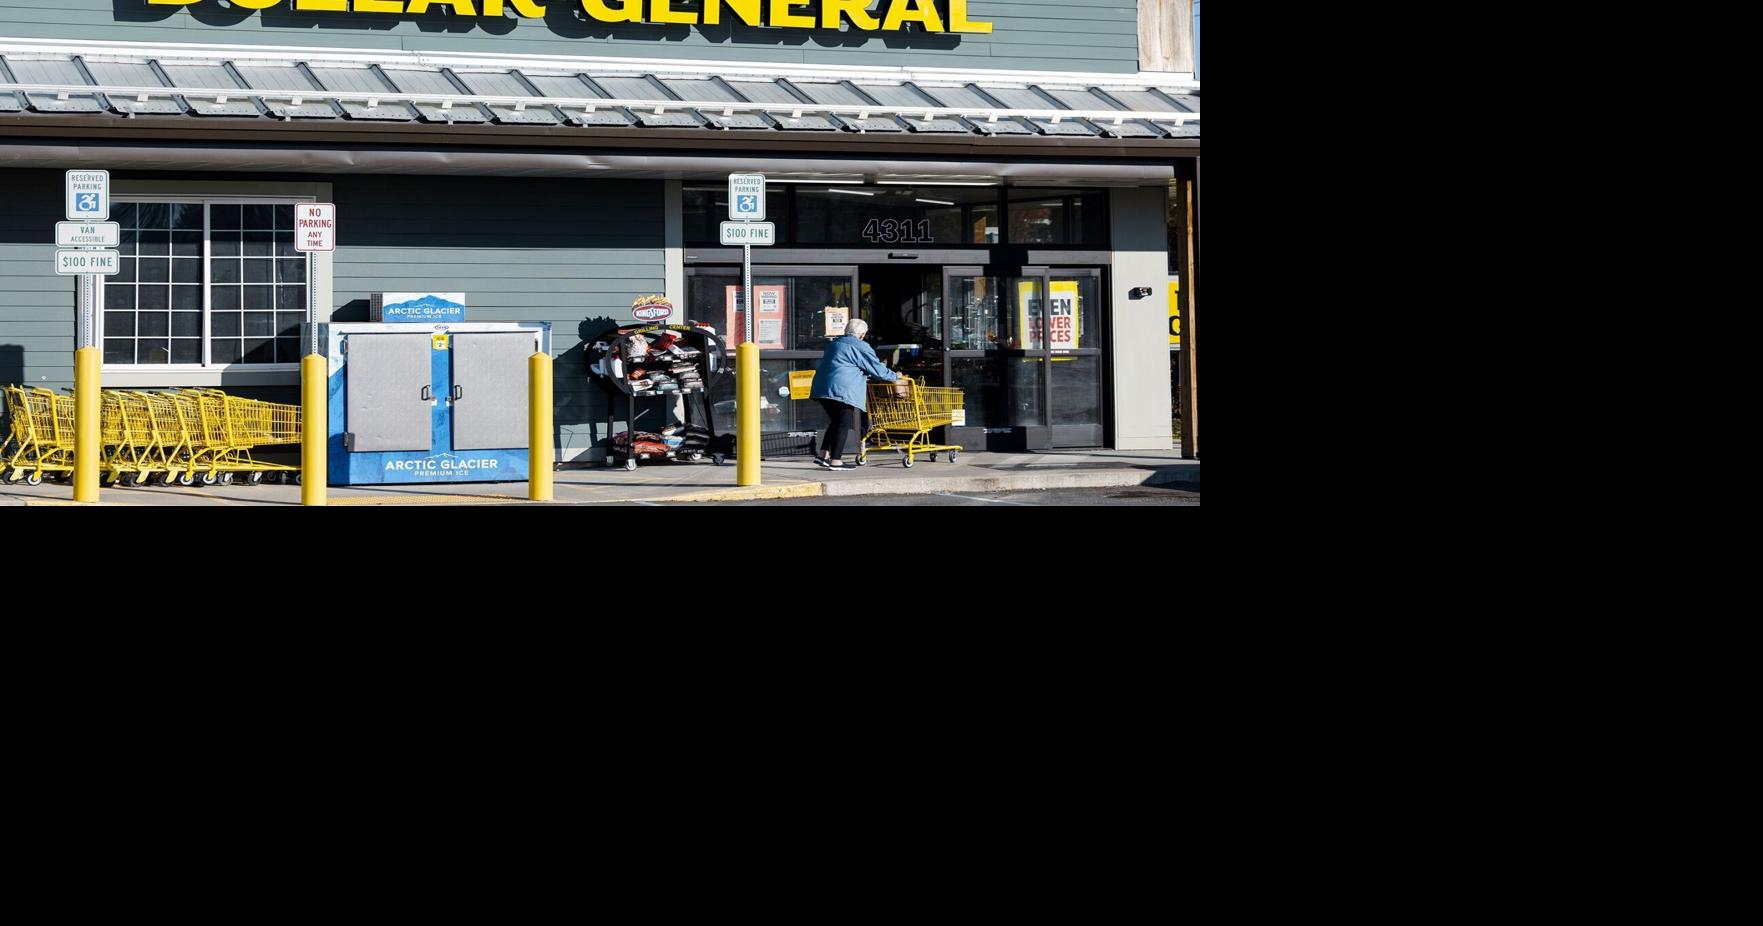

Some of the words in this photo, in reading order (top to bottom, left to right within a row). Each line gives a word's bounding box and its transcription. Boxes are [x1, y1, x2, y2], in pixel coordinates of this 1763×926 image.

[71, 174, 104, 182] RESERVED
[309, 208, 321, 217] NO
[298, 219, 332, 228] PARKING
[80, 226, 95, 234] VAN
[726, 228, 746, 238] $100
[750, 228, 769, 238] FINE
[862, 218, 935, 243] 4311
[62, 255, 86, 268] $100
[90, 256, 113, 267] FINE
[388, 307, 421, 315] ARCTIC
[423, 307, 461, 315] GLACIER
[1027, 298, 1072, 316] EEN
[635, 307, 670, 319] KINGSFORD
[1028, 330, 1071, 343] PRCES
[385, 460, 436, 470] ARCTIC
[440, 459, 498, 469] GLACIER
